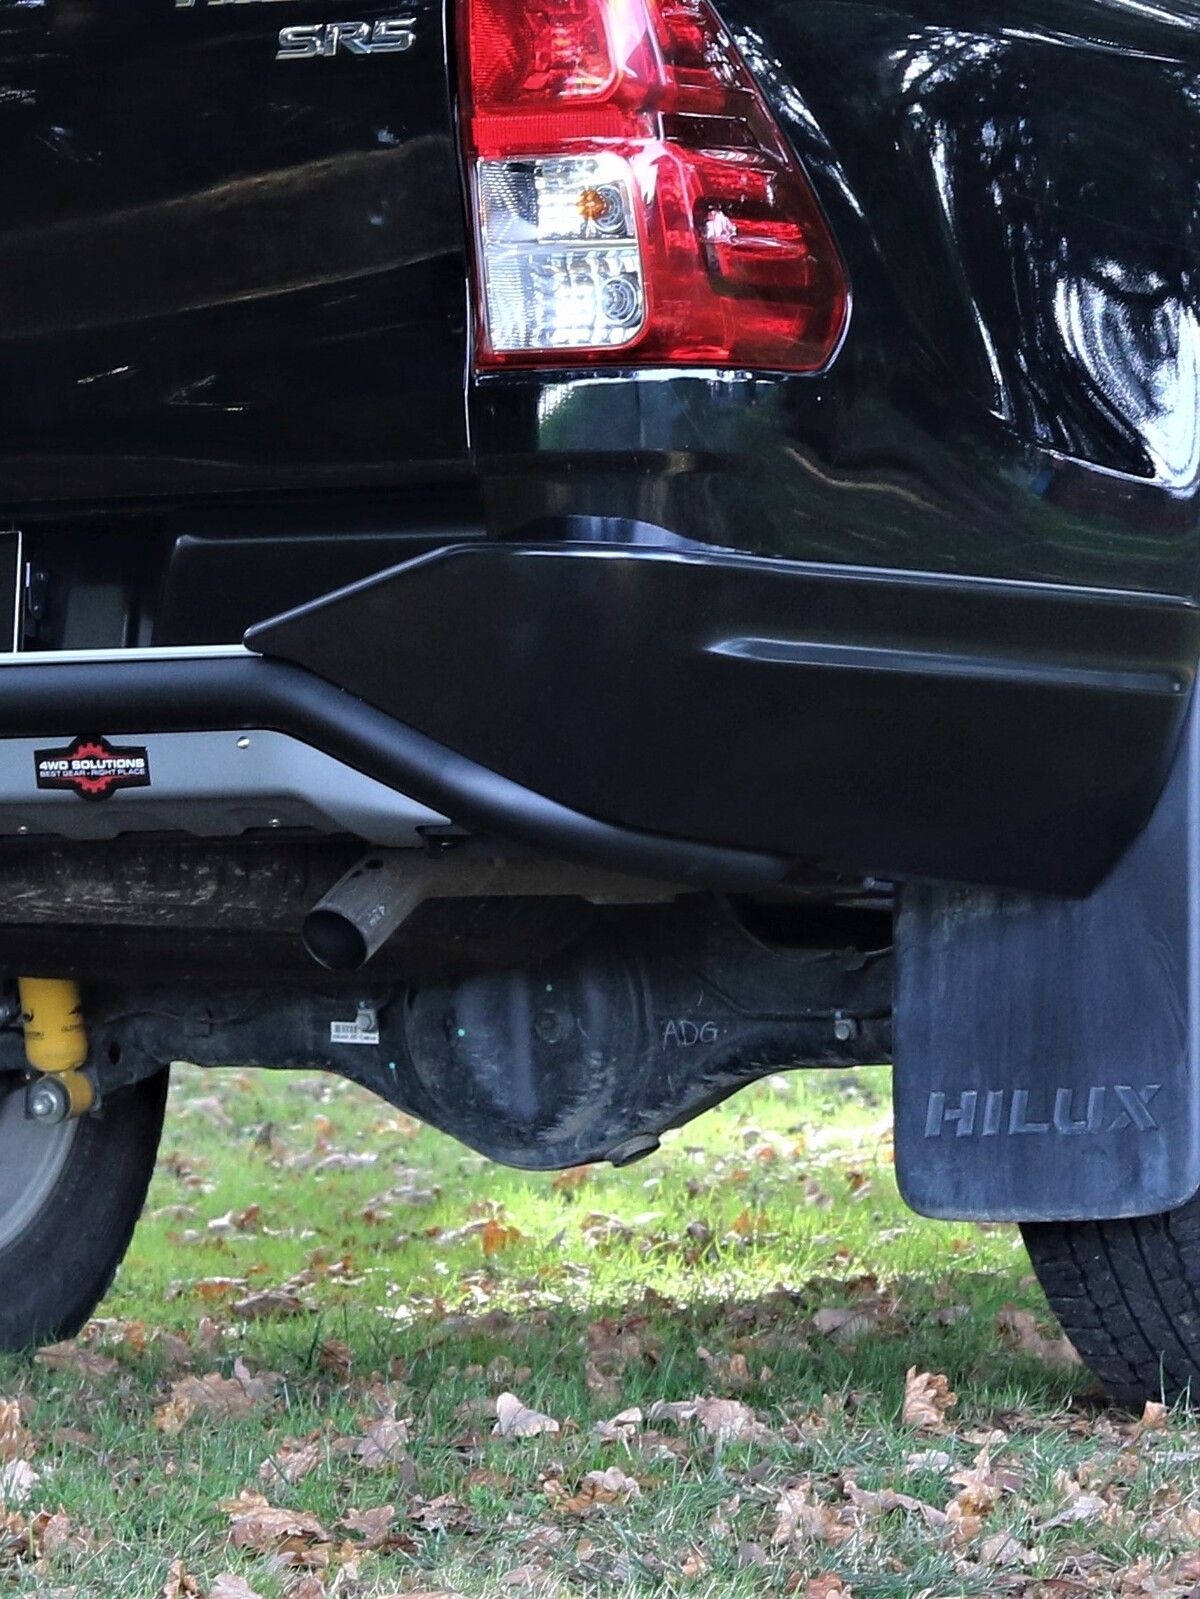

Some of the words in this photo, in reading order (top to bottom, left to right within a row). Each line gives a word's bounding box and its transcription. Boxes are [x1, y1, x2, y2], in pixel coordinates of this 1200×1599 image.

[275, 17, 417, 60] SR5
[39, 761, 68, 770] 4WD
[71, 758, 145, 769] SOLUTIONS
[91, 768, 116, 776] RIGHT
[924, 1084, 1162, 1138] HILUX
